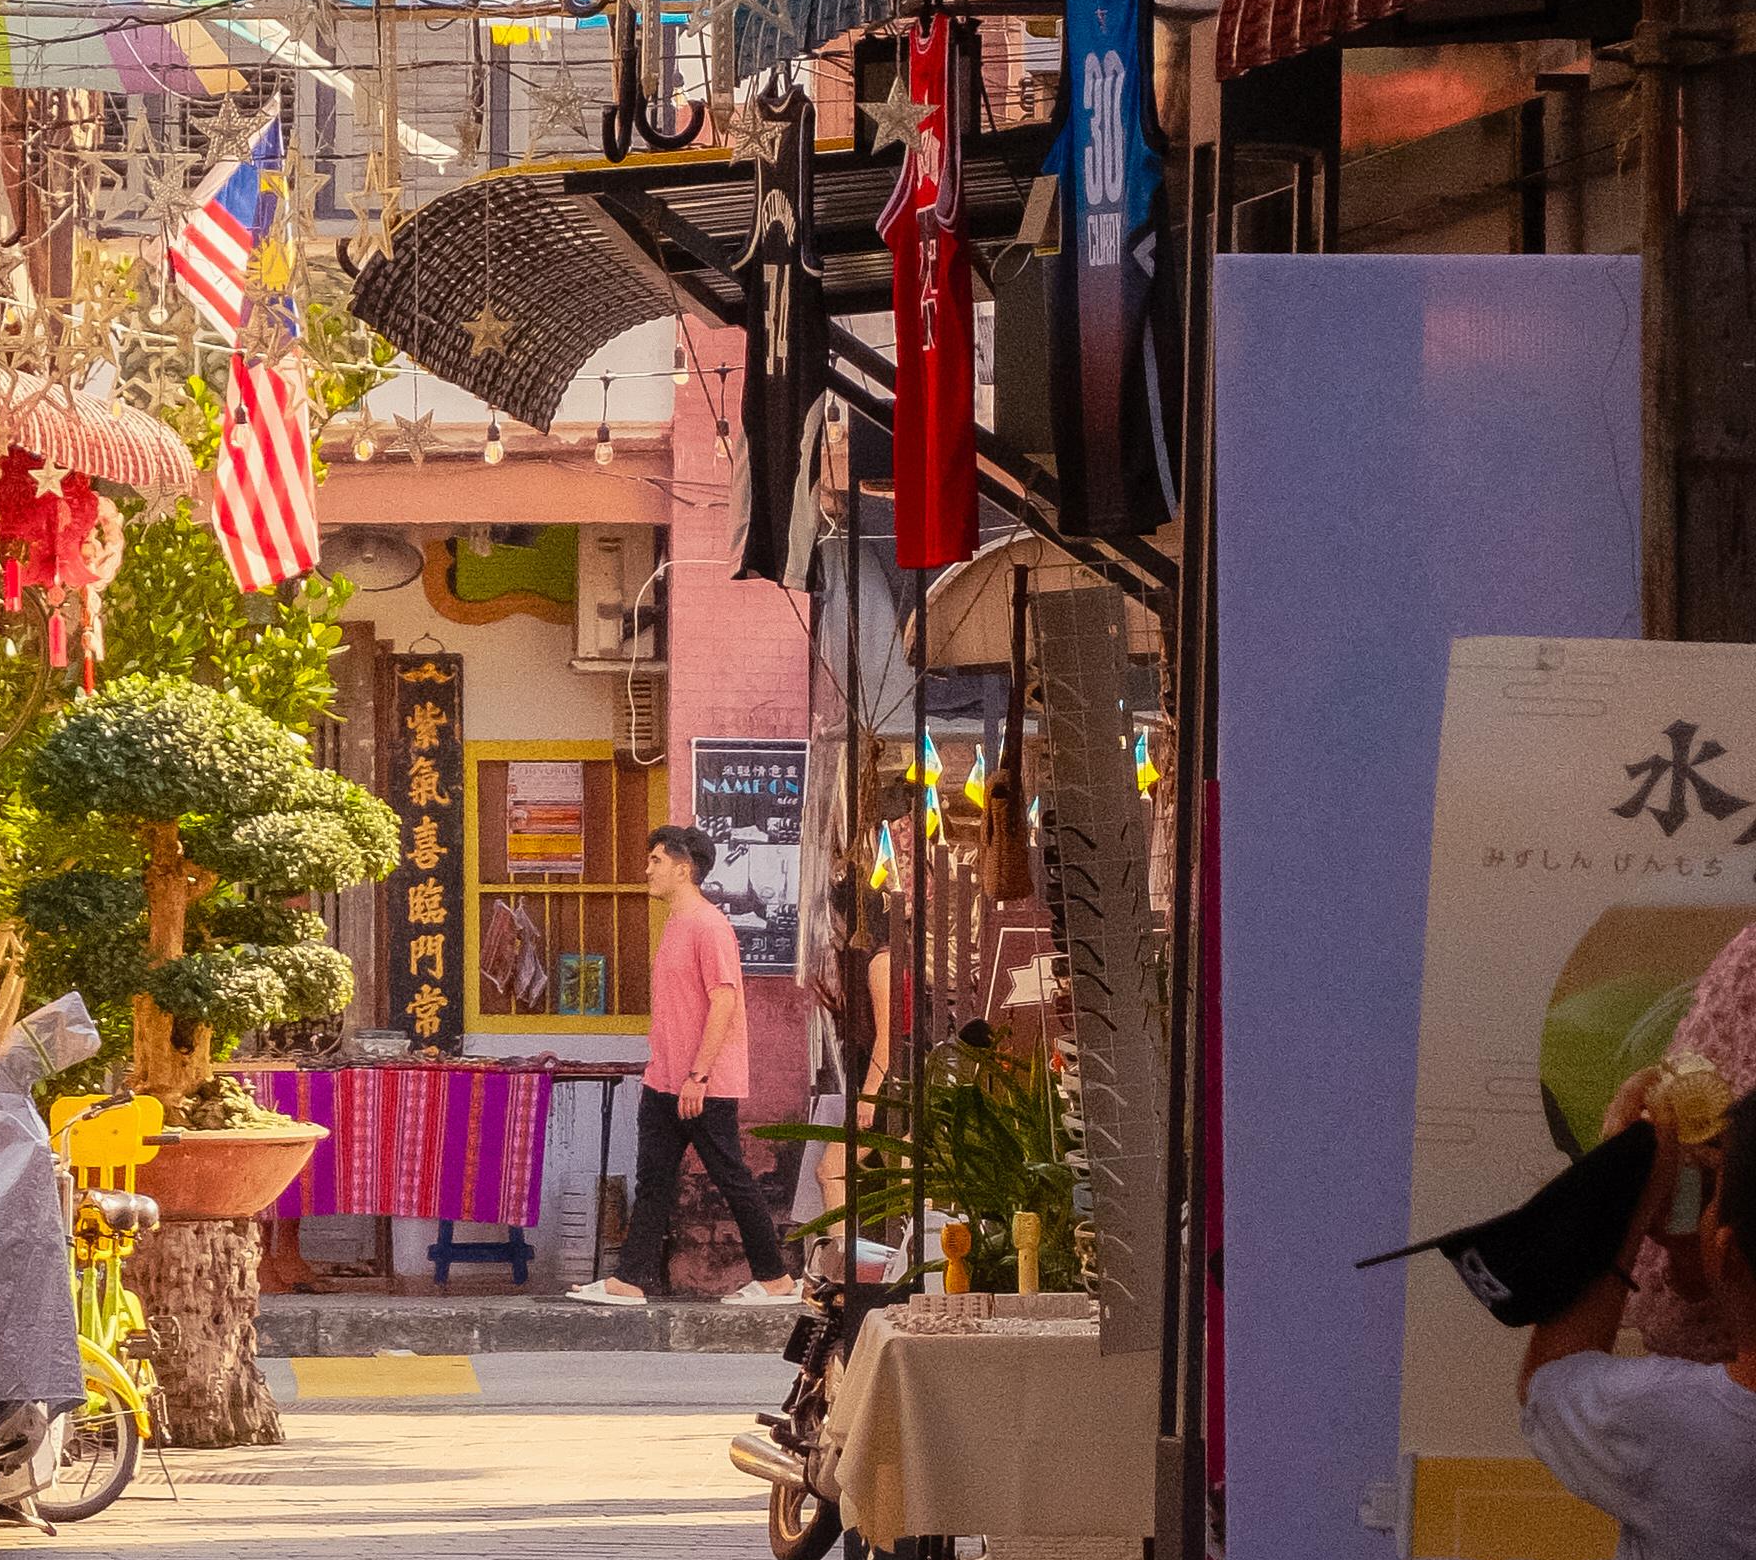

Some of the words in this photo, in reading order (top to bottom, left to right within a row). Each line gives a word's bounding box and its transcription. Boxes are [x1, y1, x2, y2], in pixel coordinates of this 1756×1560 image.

[1083, 49, 1126, 206] 30
[1086, 213, 1122, 267] CURRY
[702, 777, 763, 794] NAME
[767, 778, 799, 795] ON
[1611, 718, 1756, 845] 水
